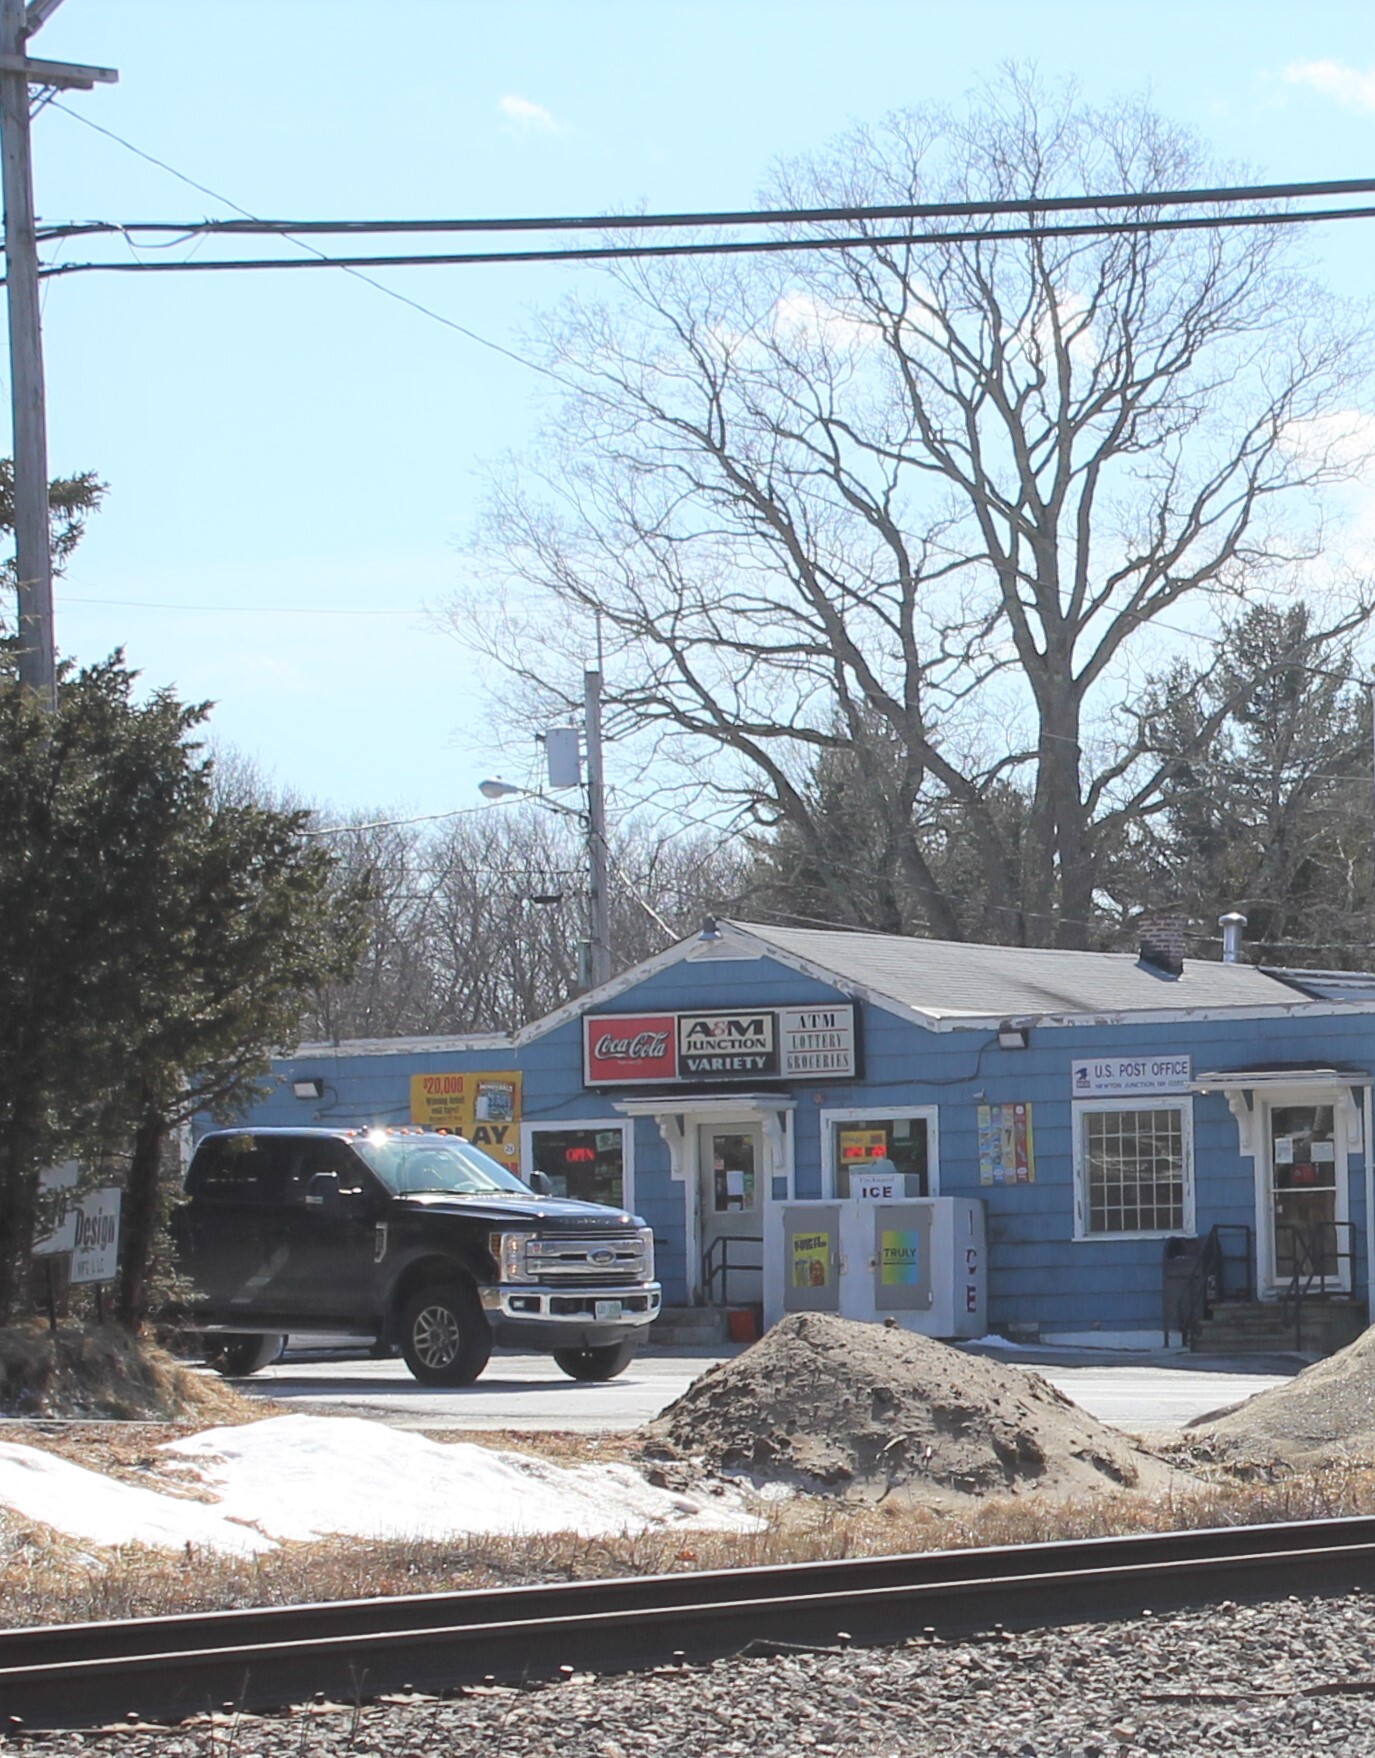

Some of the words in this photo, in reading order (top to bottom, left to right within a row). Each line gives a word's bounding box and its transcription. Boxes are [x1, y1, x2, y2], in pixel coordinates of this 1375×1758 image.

[685, 1019, 765, 1038] A&M
[797, 1013, 836, 1029] ATM
[686, 1038, 767, 1054] JUNCTION
[791, 1033, 842, 1050] LOTTERY
[686, 1055, 766, 1071] VARIETY
[787, 1053, 849, 1070] GROCERIES
[1095, 1064, 1115, 1078] U.S.
[1119, 1063, 1147, 1077] POST
[1151, 1061, 1188, 1076] OFFICE
[423, 1076, 464, 1095] $20,000
[565, 1147, 596, 1163] OPEN
[862, 1186, 893, 1198] ICE
[74, 1206, 115, 1251] Design
[883, 1248, 917, 1258] TRULY
